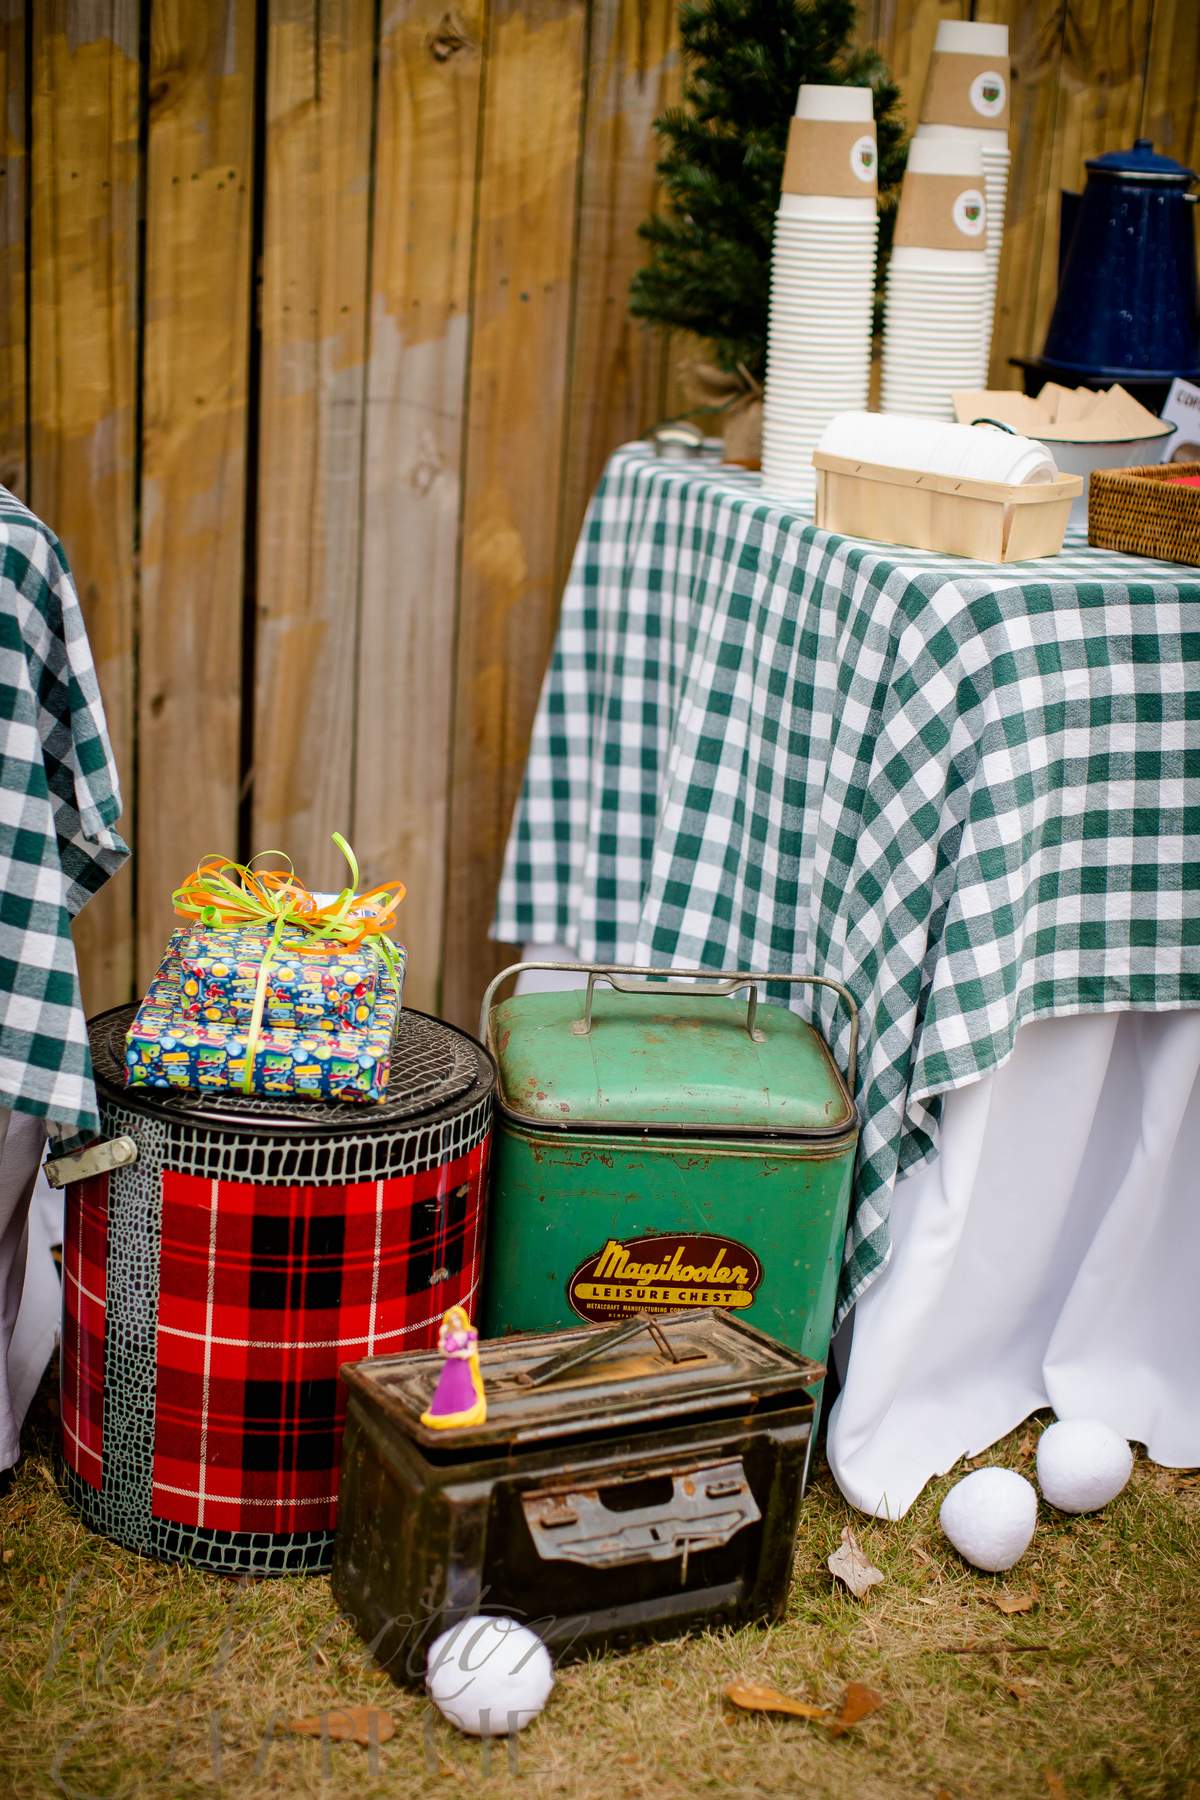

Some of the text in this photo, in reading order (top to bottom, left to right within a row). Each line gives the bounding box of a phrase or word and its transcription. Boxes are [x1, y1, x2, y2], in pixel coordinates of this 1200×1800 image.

[592, 1240, 750, 1286] Magikooler
[592, 1286, 733, 1303] LEISURE CHEST
[623, 1305, 667, 1313] MANUFACTURING
